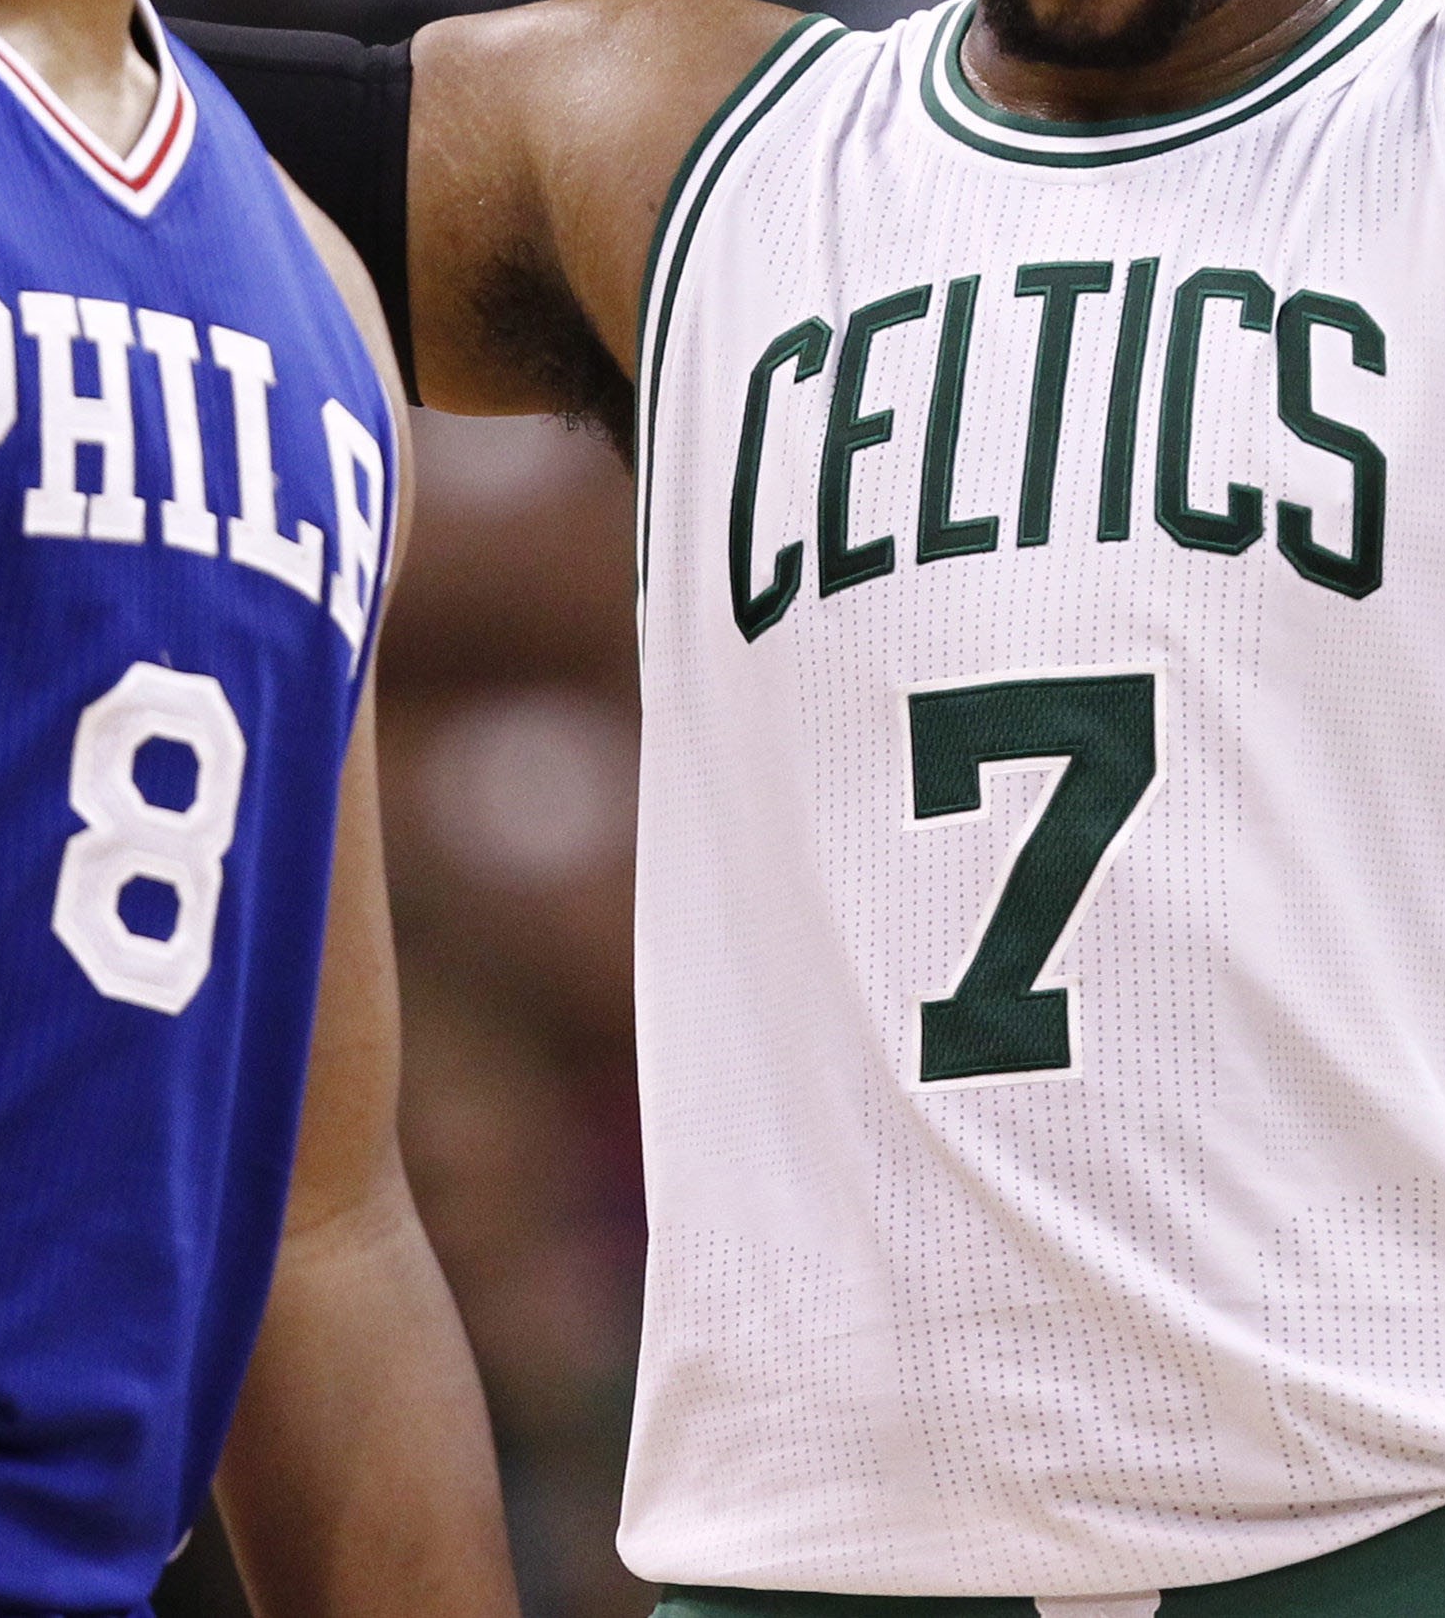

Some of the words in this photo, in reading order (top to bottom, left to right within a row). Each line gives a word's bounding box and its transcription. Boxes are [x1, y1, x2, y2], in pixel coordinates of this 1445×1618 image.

[728, 256, 1387, 644] CELTICS
[52, 660, 247, 1016] 8
[905, 669, 1161, 1086] 7
